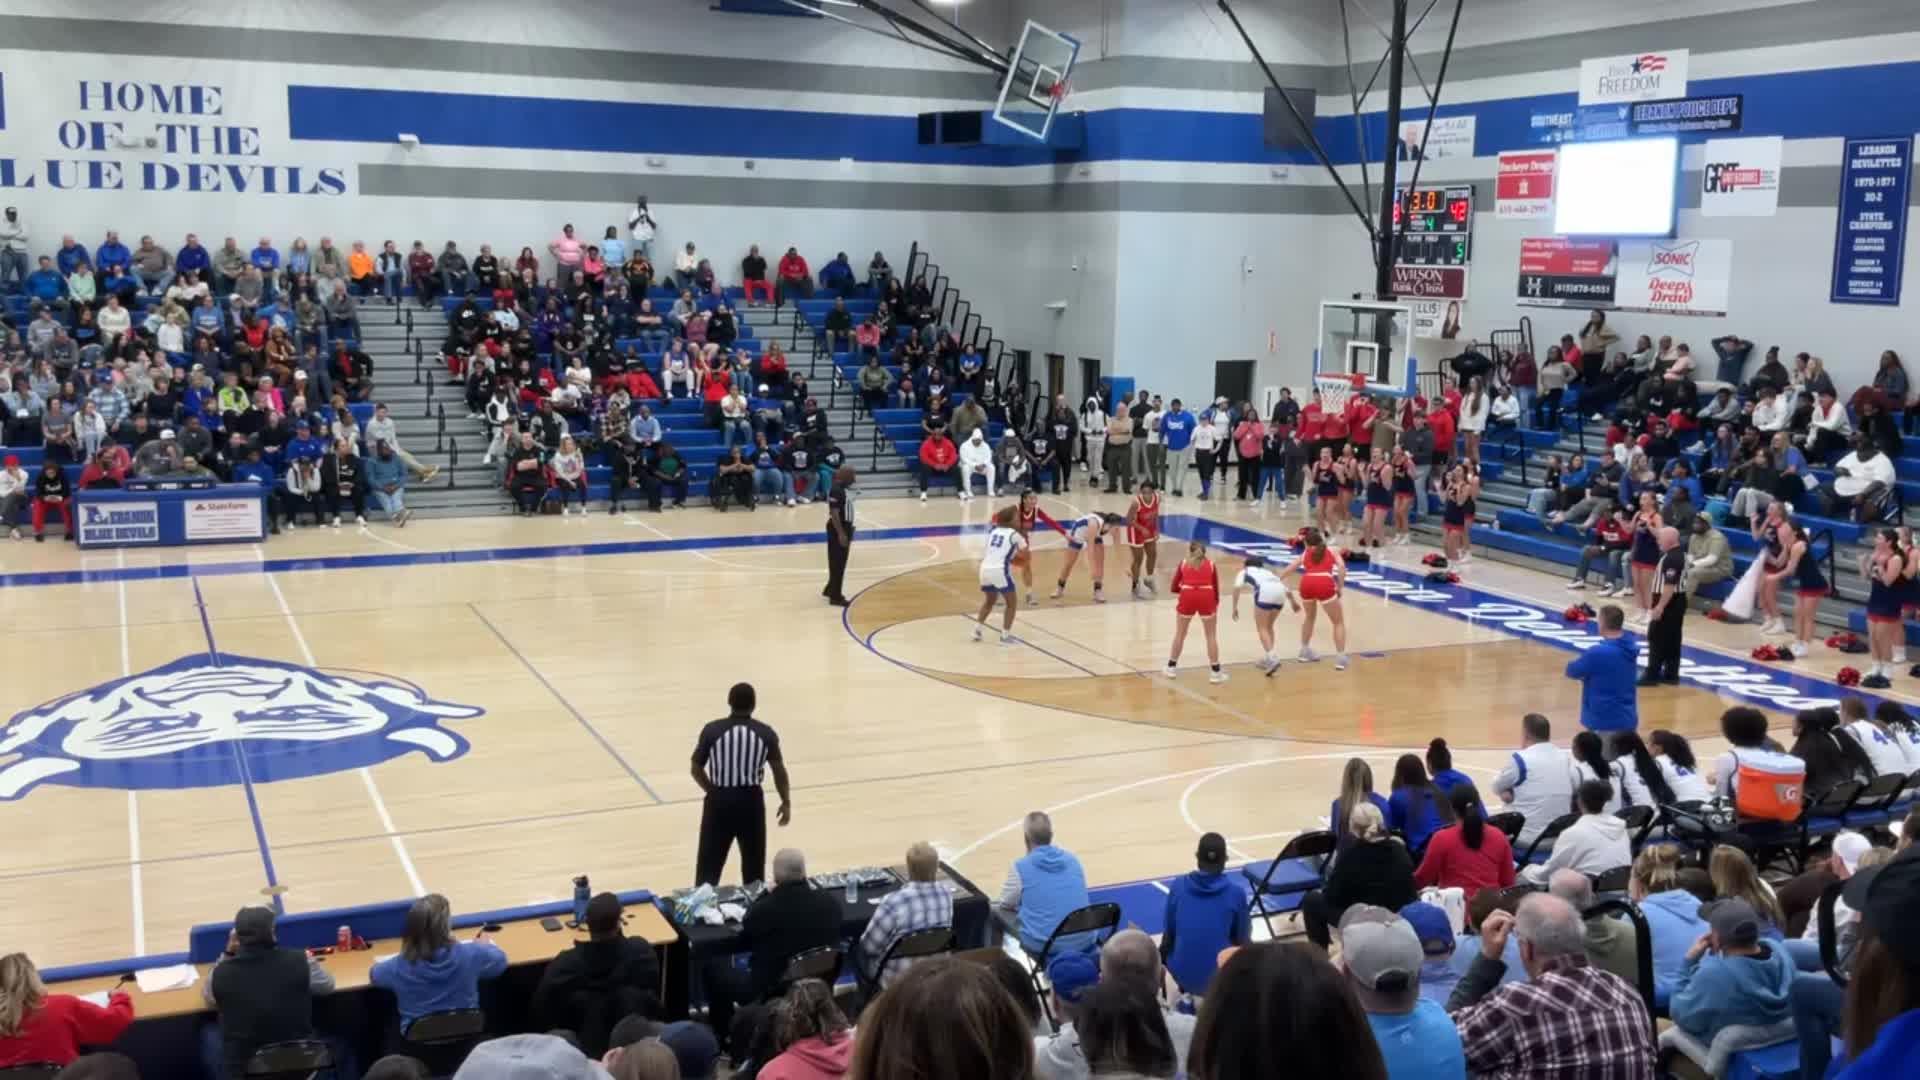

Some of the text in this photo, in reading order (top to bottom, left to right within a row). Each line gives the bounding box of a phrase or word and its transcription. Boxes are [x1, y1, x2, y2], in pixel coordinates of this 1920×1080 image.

[1599, 75, 1661, 94] FREEDOM
[79, 80, 223, 115] HOME
[58, 120, 260, 156] OF THE
[1859, 145, 1896, 155] LEBANON
[1852, 158, 1902, 168] DEVILETTES
[0, 158, 347, 196] LUE DEVILS
[1655, 252, 1691, 265] SONIC
[1396, 268, 1443, 281] WILSON
[1392, 281, 1412, 292] Bank
[1425, 282, 1444, 293] Trust
[84, 527, 156, 541] BLUE DEVILS
